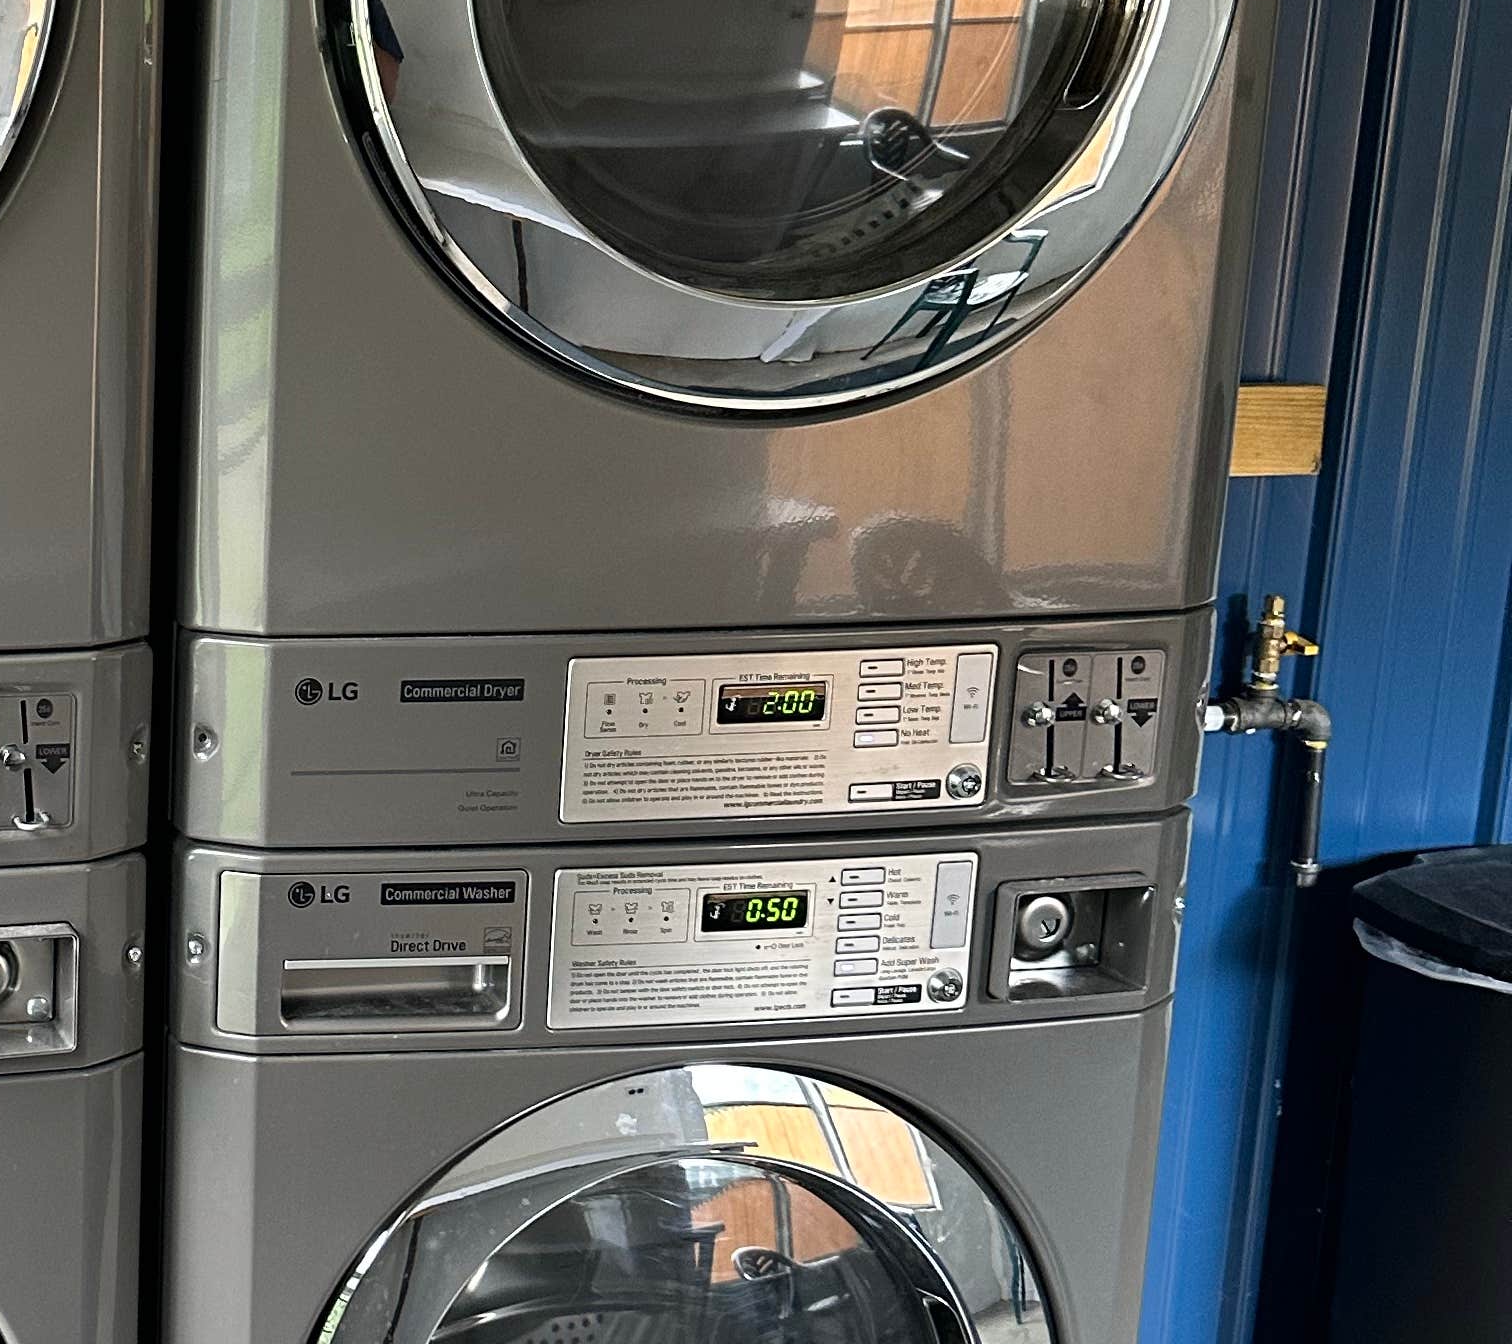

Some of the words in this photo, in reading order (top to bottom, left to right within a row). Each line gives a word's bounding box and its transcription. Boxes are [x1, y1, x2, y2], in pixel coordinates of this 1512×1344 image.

[627, 677, 666, 686] Processing
[774, 672, 810, 681] Remaining
[328, 682, 358, 701] LG
[404, 684, 481, 698] Commercial
[484, 684, 521, 699] Dryer
[613, 887, 652, 895] Processing
[740, 882, 756, 890] Time
[320, 885, 350, 904] LG
[385, 887, 459, 901] Commercial
[462, 886, 512, 900] Washer
[391, 940, 429, 953] Direct
[433, 939, 466, 952] Drive
